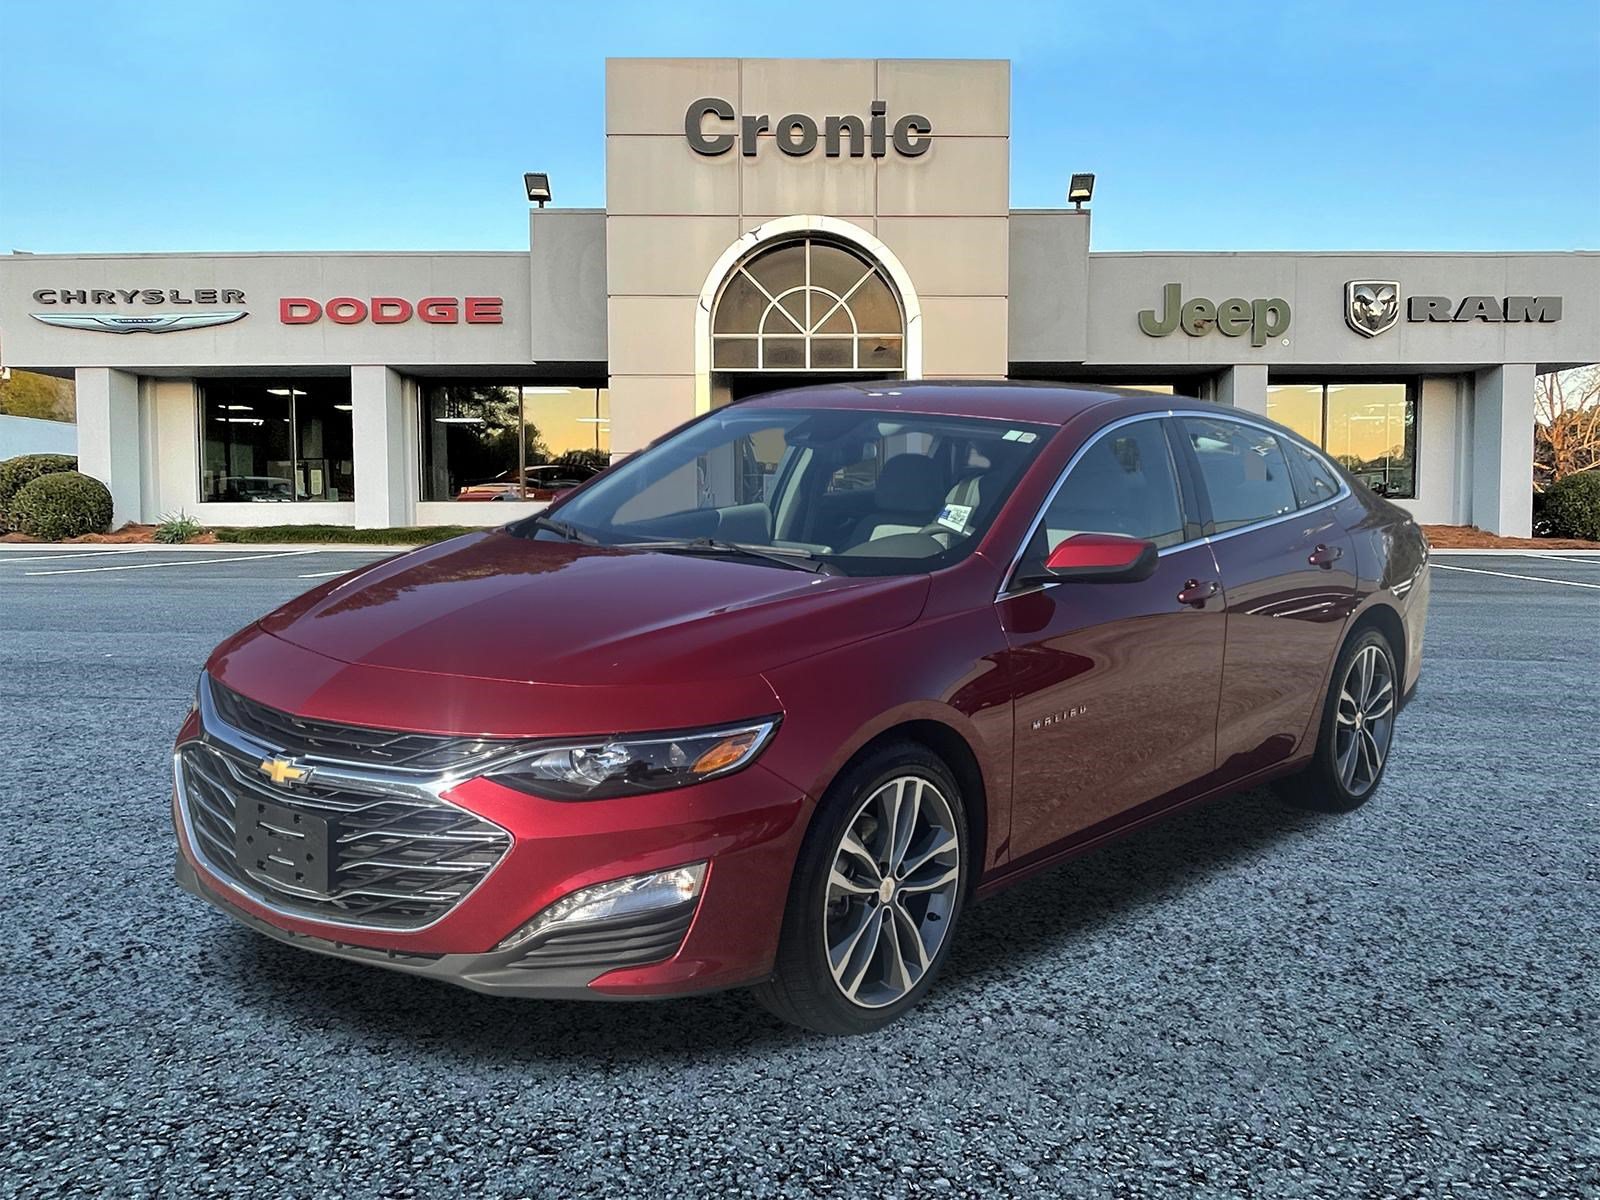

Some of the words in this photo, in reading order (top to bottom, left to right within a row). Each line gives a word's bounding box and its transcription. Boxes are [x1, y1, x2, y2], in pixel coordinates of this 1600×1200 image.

[685, 98, 932, 158] Cronic
[32, 289, 246, 304] CHRYSLER
[1408, 296, 1563, 323] RAM
[280, 297, 504, 324] DODGE
[1138, 283, 1291, 347] Jeep
[1032, 705, 1087, 730] MALIBU
